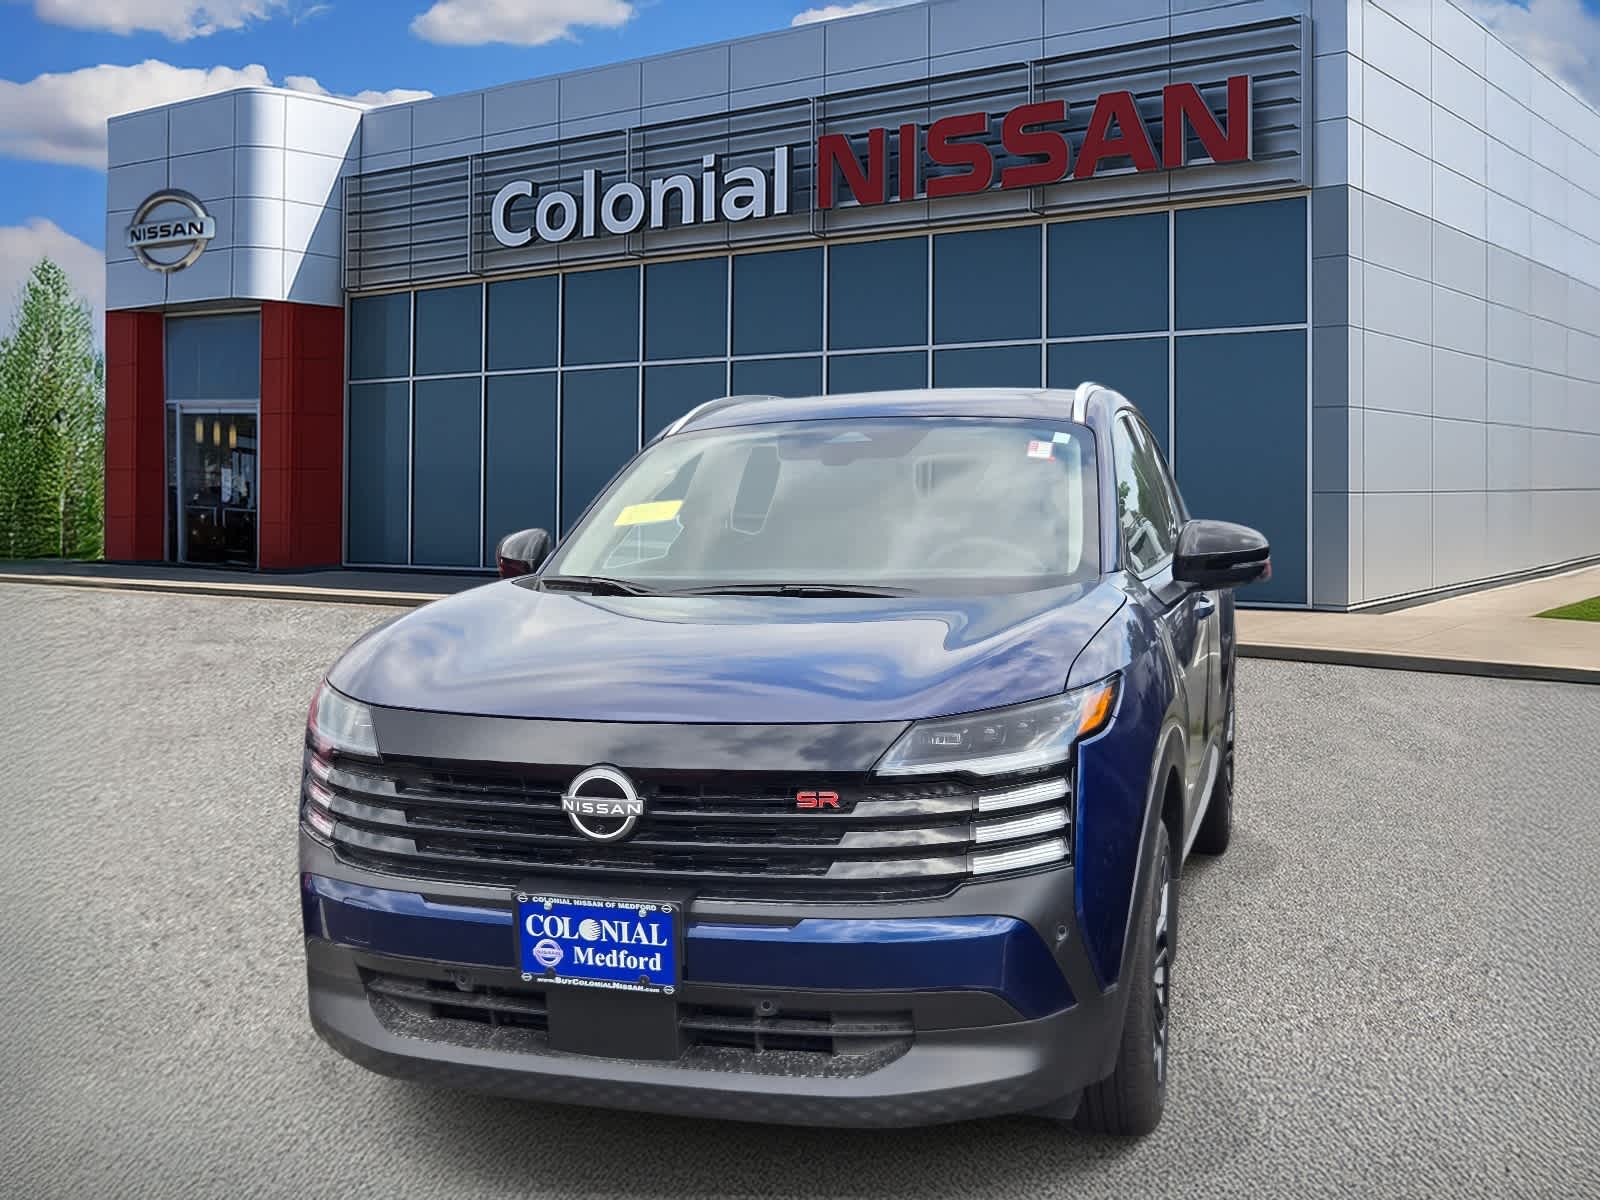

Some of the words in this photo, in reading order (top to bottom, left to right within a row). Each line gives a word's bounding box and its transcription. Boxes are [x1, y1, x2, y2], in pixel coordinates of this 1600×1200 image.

[491, 145, 790, 248] Colonial
[817, 75, 1254, 210] NISSAN
[130, 221, 204, 242] NISSAN
[562, 799, 642, 815] NISSAN
[796, 791, 840, 808] SR
[532, 896, 572, 905] COLONIAL
[573, 900, 604, 908] NISSAN
[618, 903, 657, 912] MEDFORD
[525, 914, 668, 946] COLONIAL
[573, 946, 662, 971] Medford
